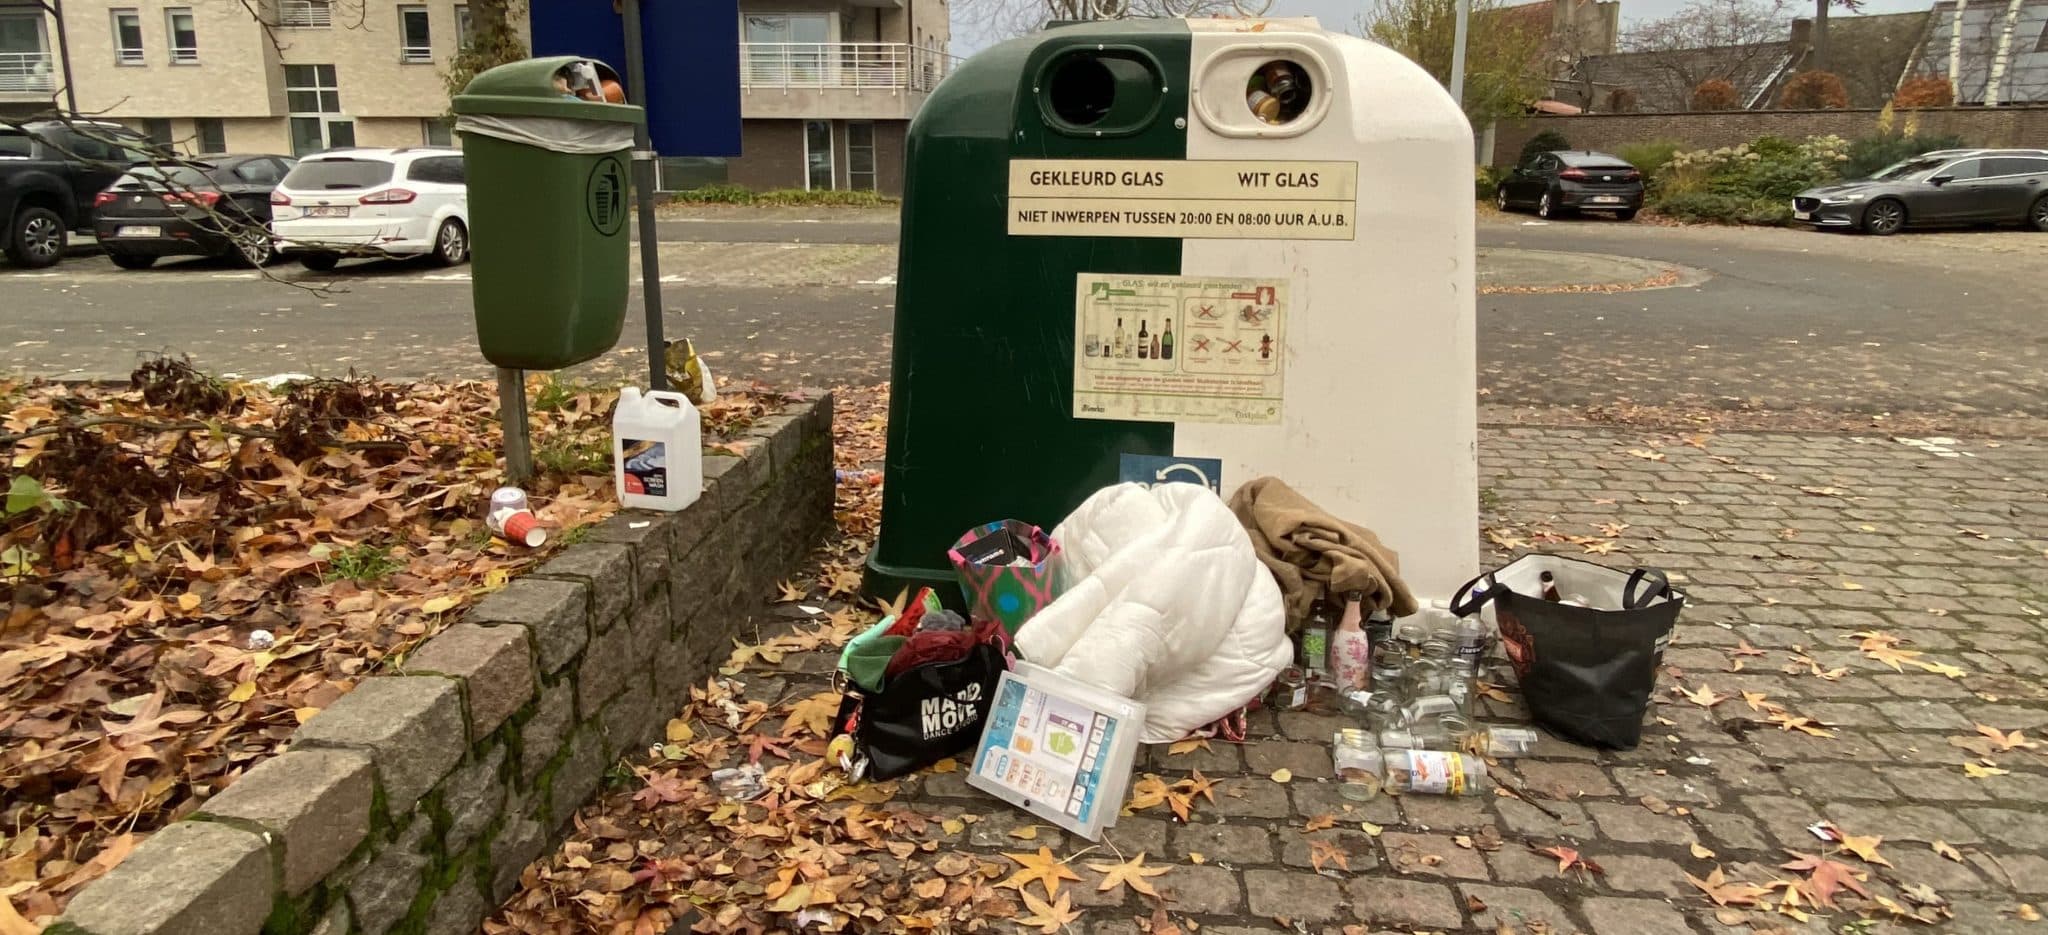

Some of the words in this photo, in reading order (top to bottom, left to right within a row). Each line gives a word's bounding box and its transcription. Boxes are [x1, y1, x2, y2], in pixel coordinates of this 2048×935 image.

[1030, 171, 1117, 187] GEKLEURD
[1121, 172, 1164, 187] GLAS
[1237, 172, 1269, 188] WIT
[1275, 173, 1319, 188] GLAS
[1018, 210, 1048, 223] NIET
[1051, 211, 1120, 224] INWERPEN
[1124, 211, 1176, 225] TUSSEN
[1179, 212, 1212, 225] 20:00
[1216, 212, 1234, 225] EN
[1238, 213, 1271, 226] 08:00
[1275, 213, 1304, 226] UUR
[1307, 213, 1348, 227] A.U.B.
[922, 703, 977, 734] MOVE
[923, 728, 952, 741] DANCE
